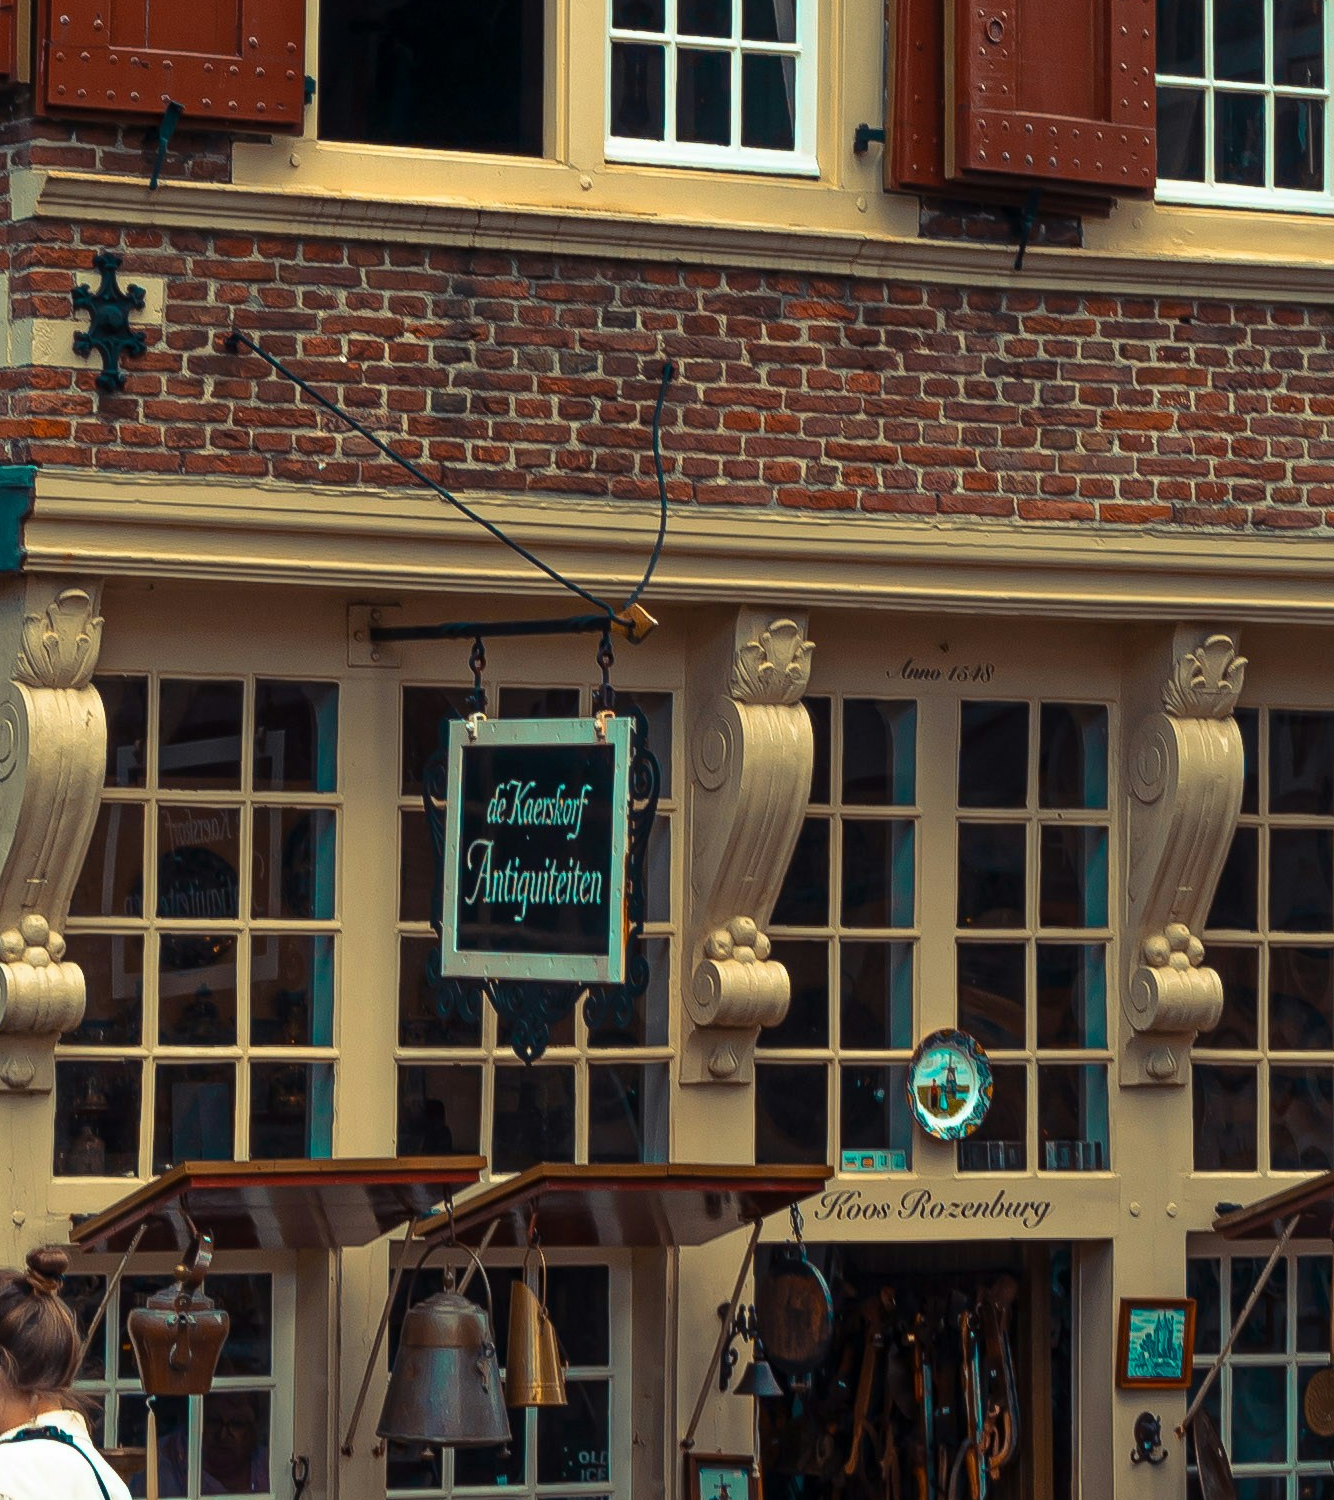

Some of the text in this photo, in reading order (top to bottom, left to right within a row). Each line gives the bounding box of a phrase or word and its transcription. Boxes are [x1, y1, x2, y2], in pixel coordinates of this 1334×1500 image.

[886, 658, 942, 681] Anno
[486, 782, 507, 825] de
[464, 838, 603, 923] Antiquiteiten
[814, 1187, 1053, 1230] Koos Rozenburg
